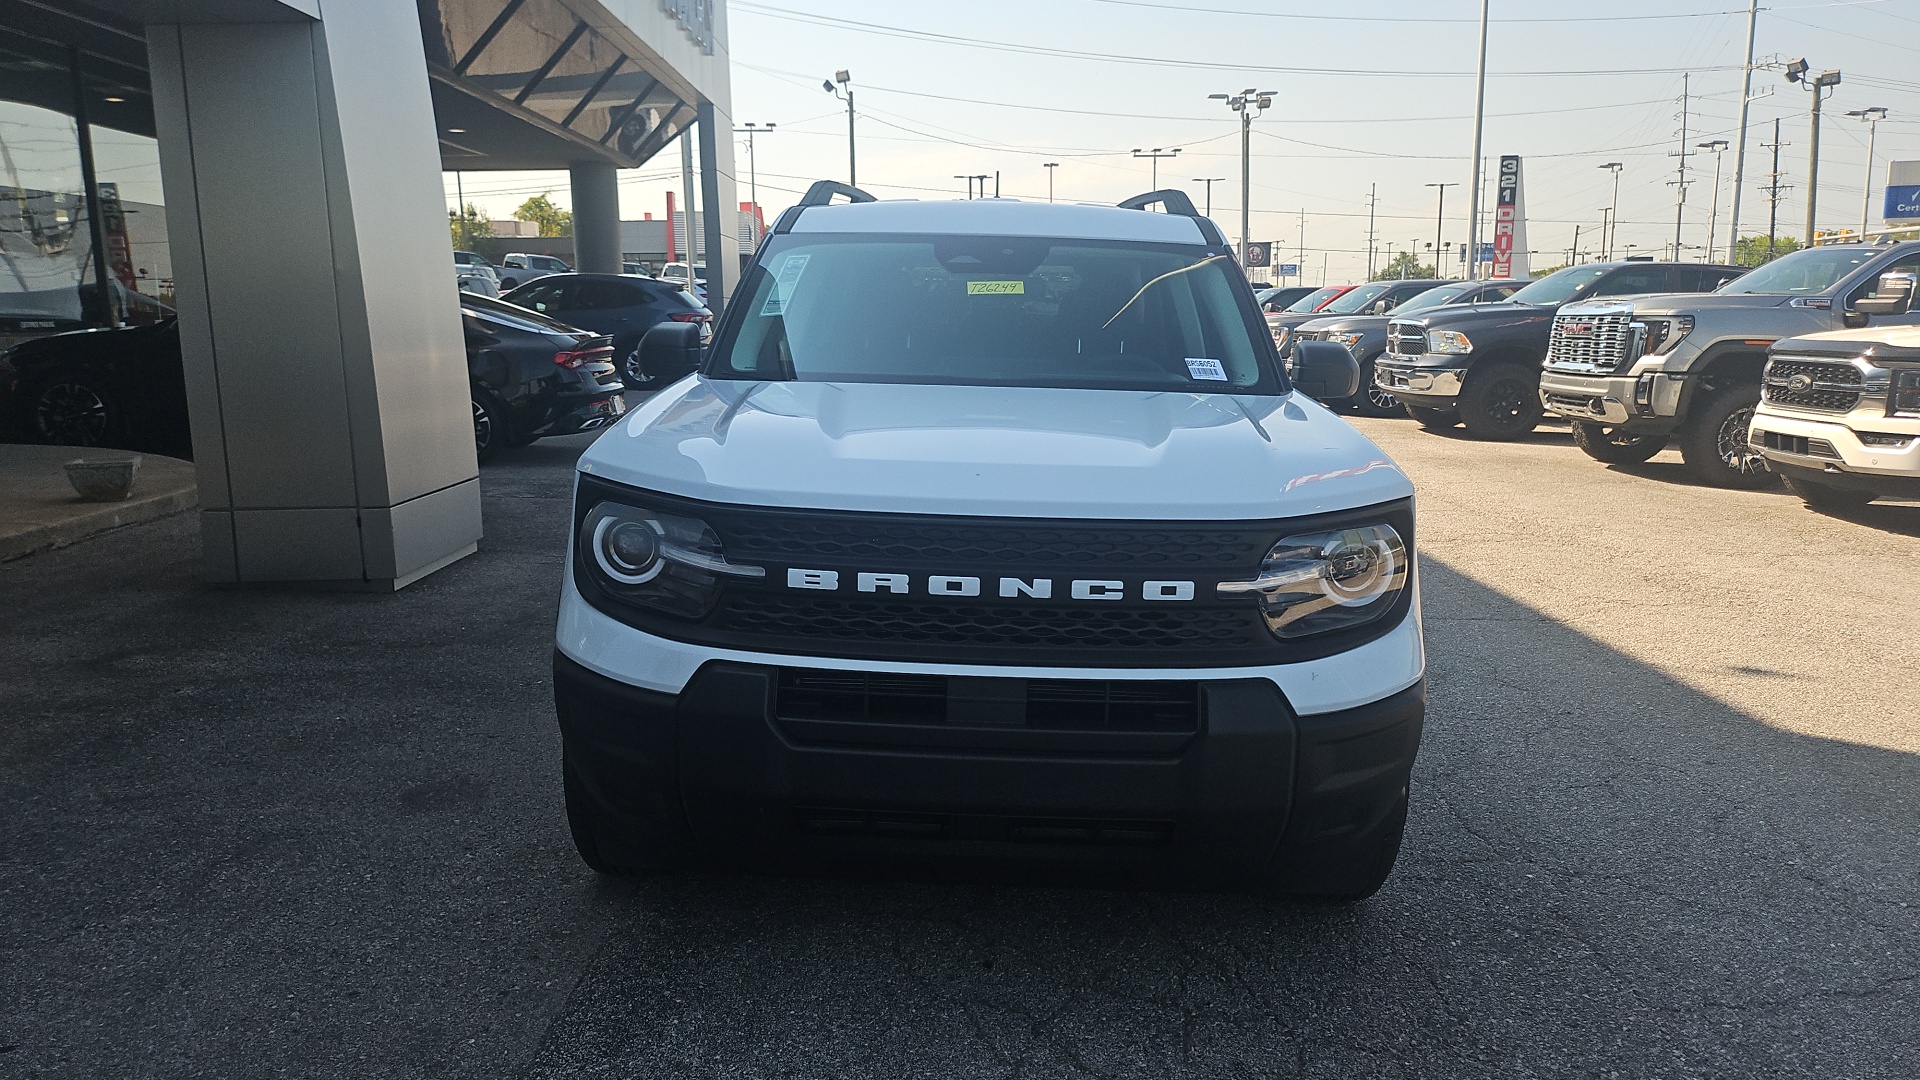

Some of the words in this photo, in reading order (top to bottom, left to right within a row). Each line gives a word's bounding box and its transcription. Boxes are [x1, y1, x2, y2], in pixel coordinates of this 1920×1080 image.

[1501, 160, 1517, 202] 321
[1495, 208, 1515, 276] DRIVE
[1563, 323, 1592, 335] GMC
[787, 568, 1195, 600] BRONCO
